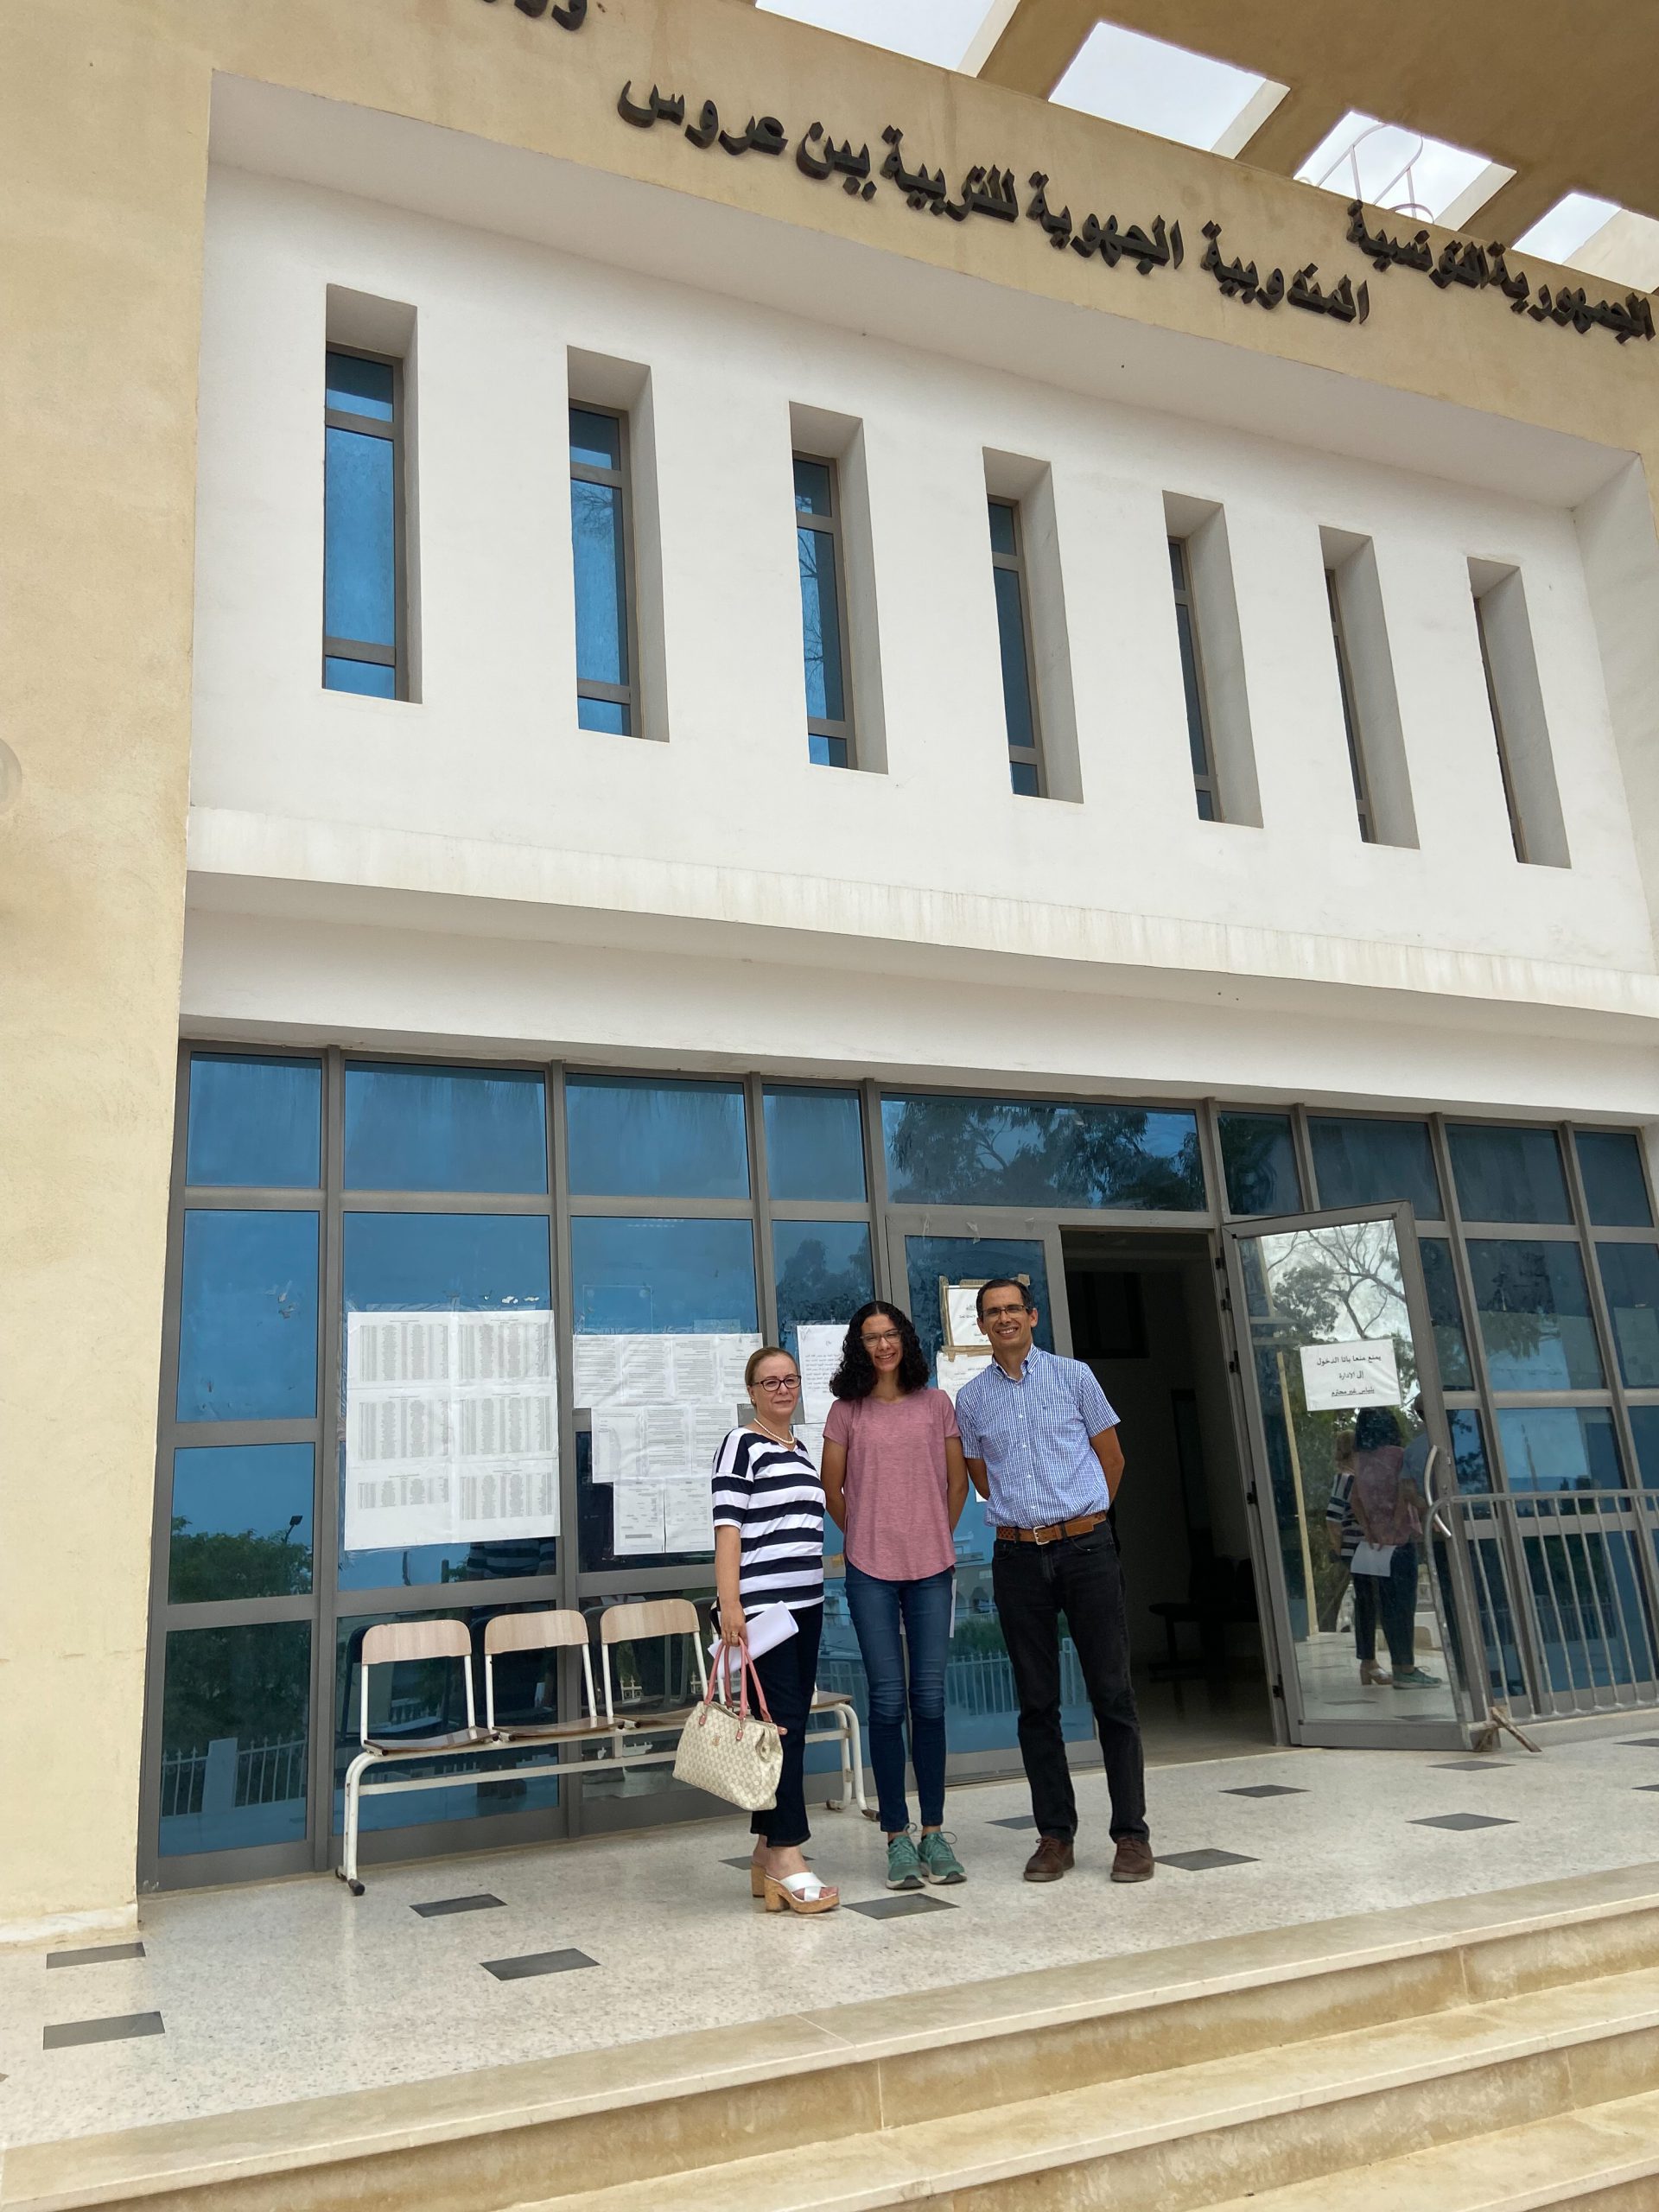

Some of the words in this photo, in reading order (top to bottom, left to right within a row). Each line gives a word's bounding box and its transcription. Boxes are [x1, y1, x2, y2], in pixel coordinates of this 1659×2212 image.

[617, 79, 789, 156] عروس
[796, 121, 877, 202] ببن
[880, 124, 1020, 225] للتربية
[1026, 170, 1185, 276] الجهوية
[1345, 200, 1490, 290] التونسية
[1200, 219, 1370, 325] المندوبية
[1486, 239, 1656, 344] الجمهورية
[1316, 1357, 1339, 1366] الدخول
